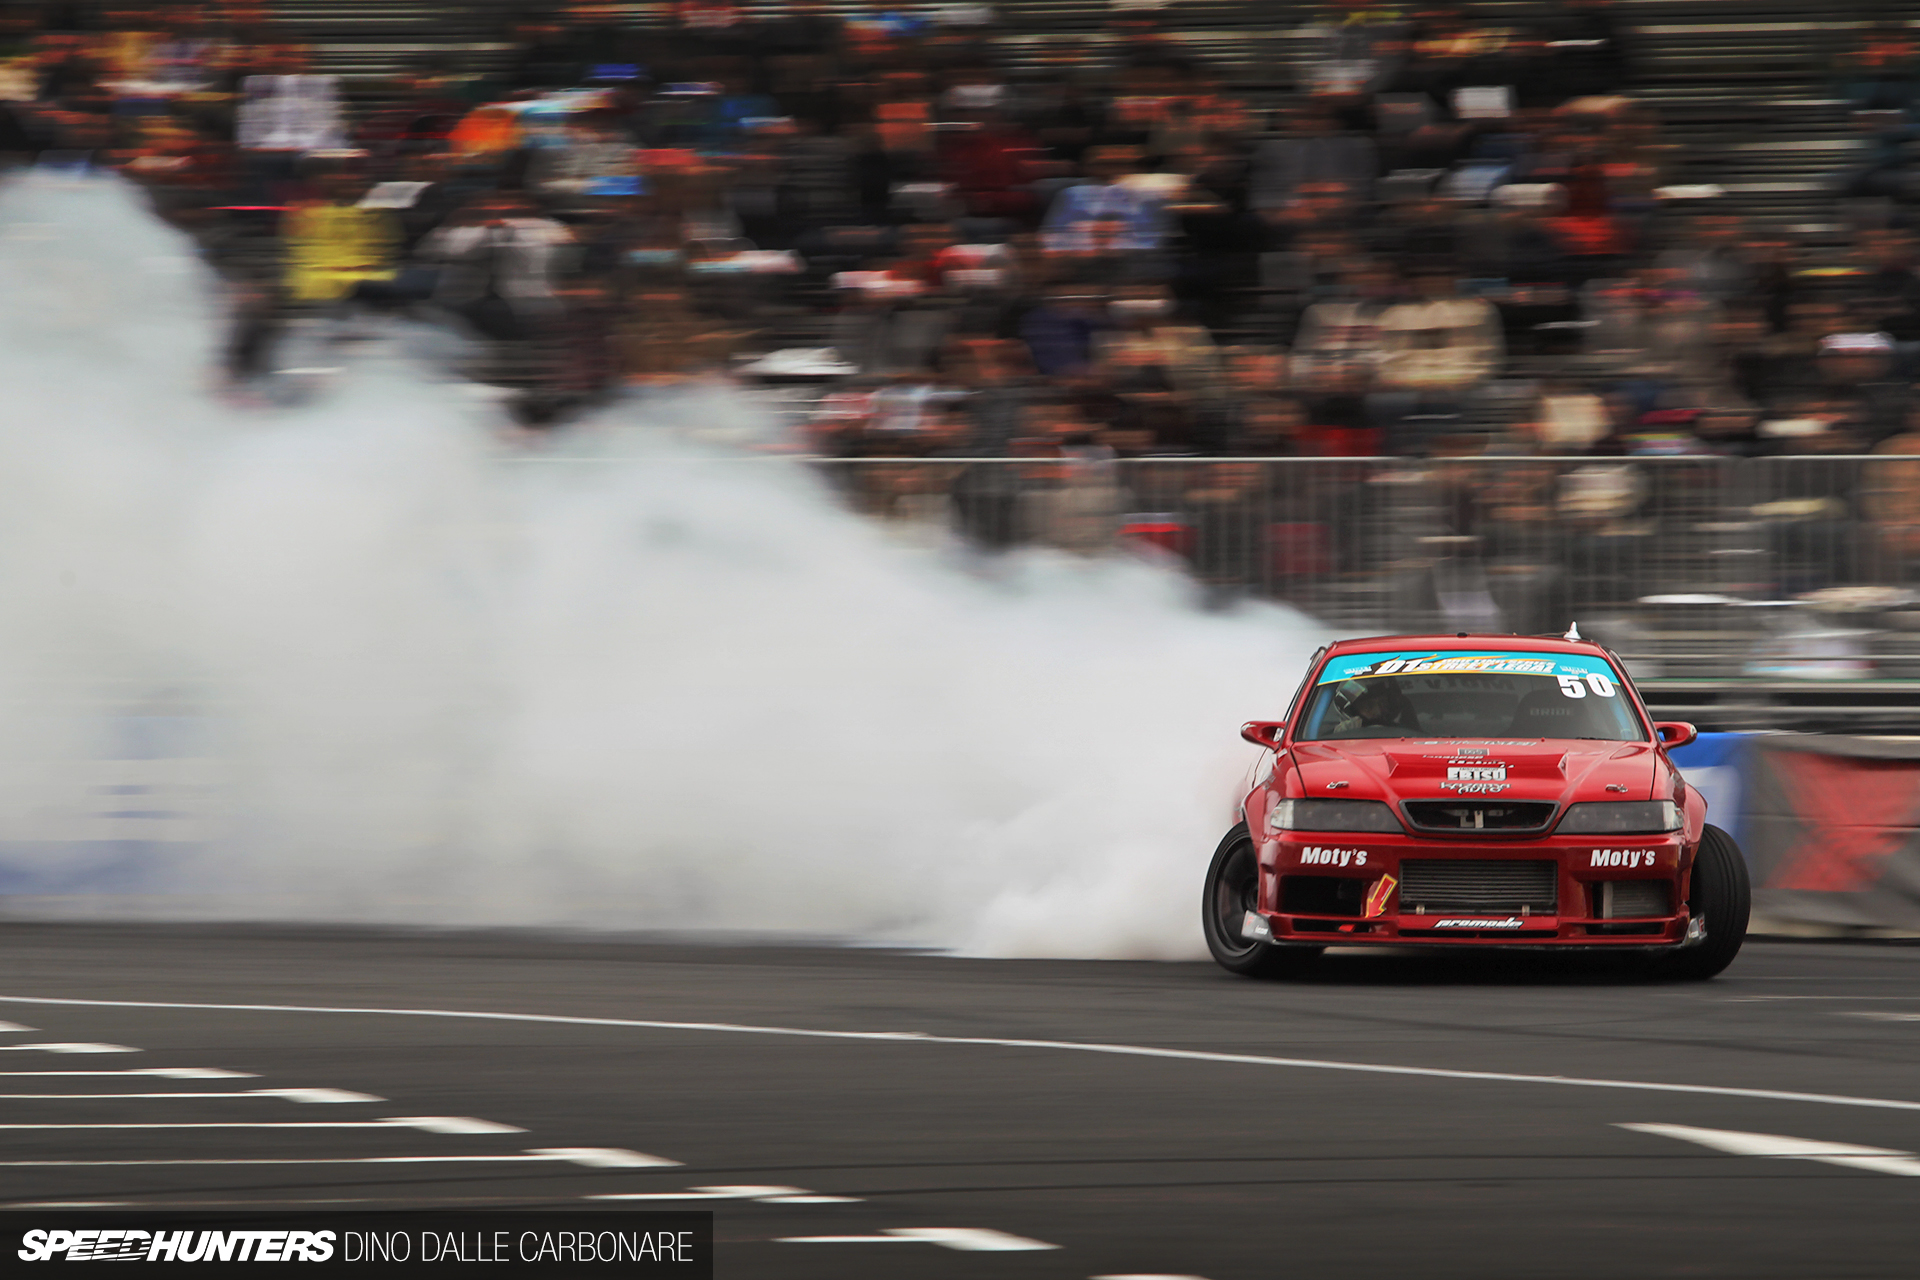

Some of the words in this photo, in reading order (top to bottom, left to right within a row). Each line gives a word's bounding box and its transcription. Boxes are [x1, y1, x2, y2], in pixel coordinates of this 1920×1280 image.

[1557, 673, 1616, 699] 50
[1299, 846, 1368, 868] Moty's
[1589, 848, 1656, 869] Moty's
